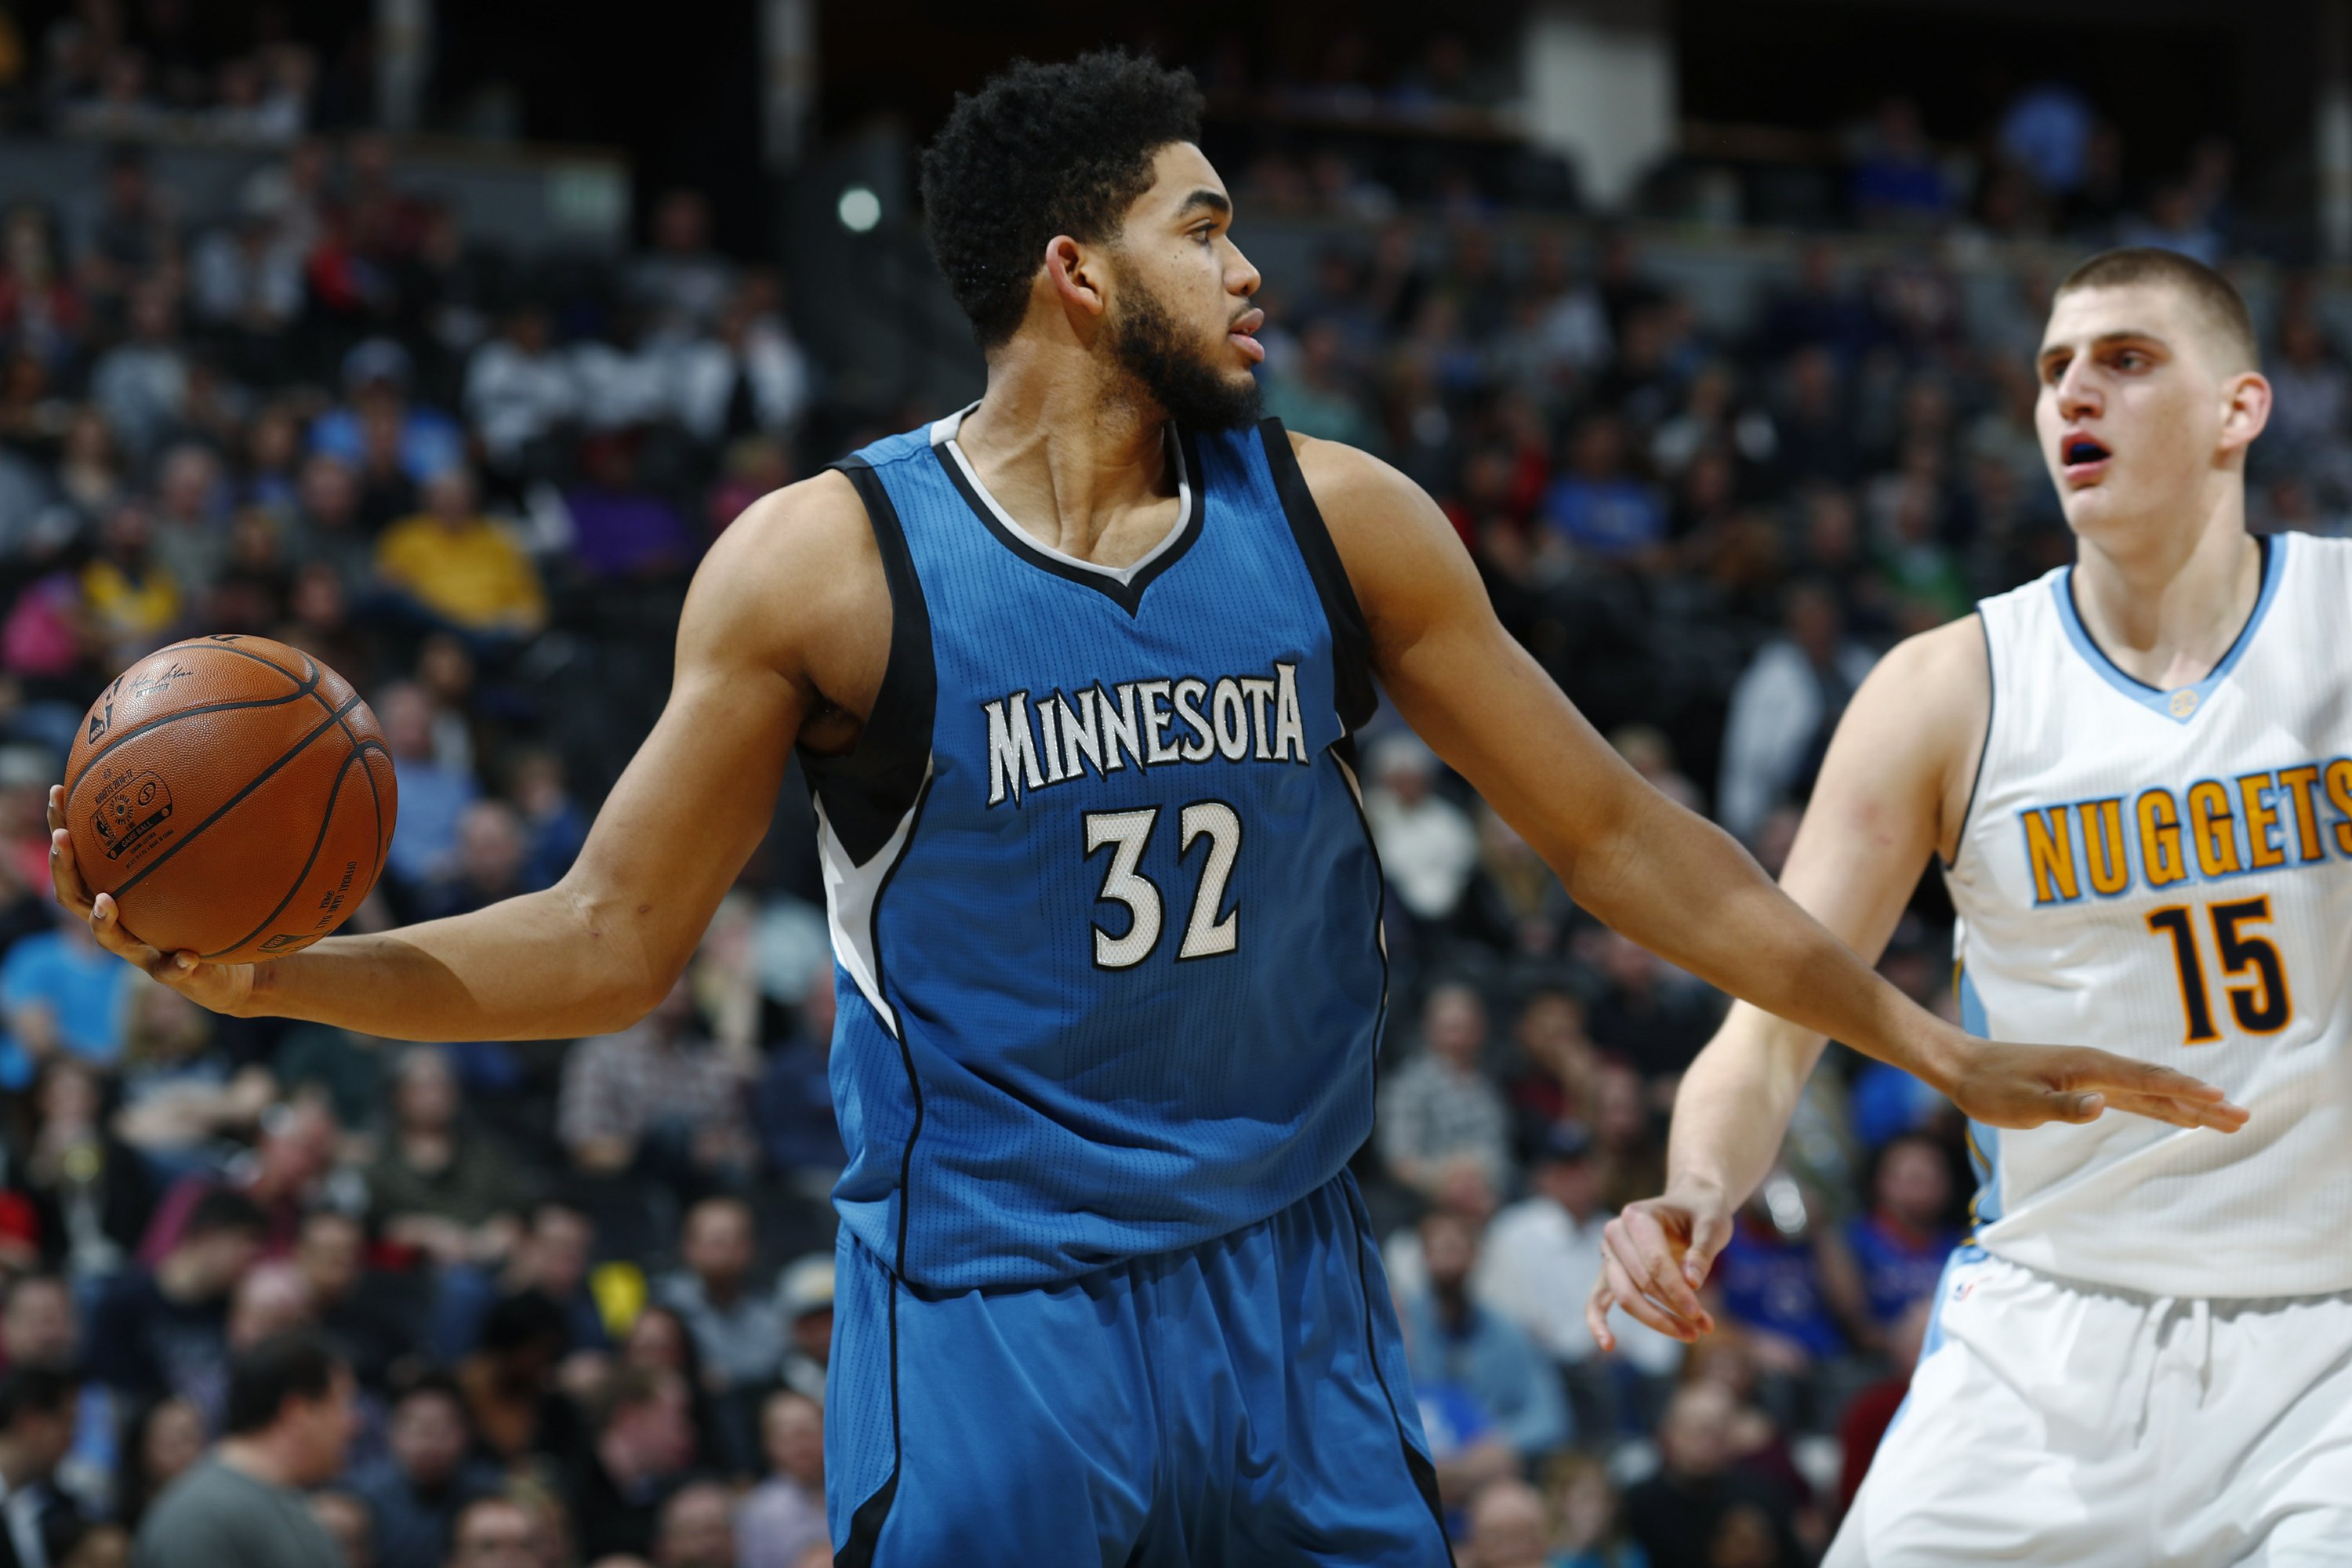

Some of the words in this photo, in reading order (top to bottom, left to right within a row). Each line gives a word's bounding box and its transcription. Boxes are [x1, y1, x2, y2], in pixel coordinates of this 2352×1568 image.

[982, 662, 1311, 809] MINNESOTA
[122, 831, 138, 848] GAME
[136, 821, 154, 835] BALL
[2016, 754, 2352, 909] NUGGETS
[338, 862, 357, 892] OFFICIAL
[1083, 798, 1243, 971] 32
[319, 891, 335, 909] @NBA
[328, 895, 344, 913] GAME
[314, 914, 332, 930] BALL
[2144, 894, 2294, 1047] 15
